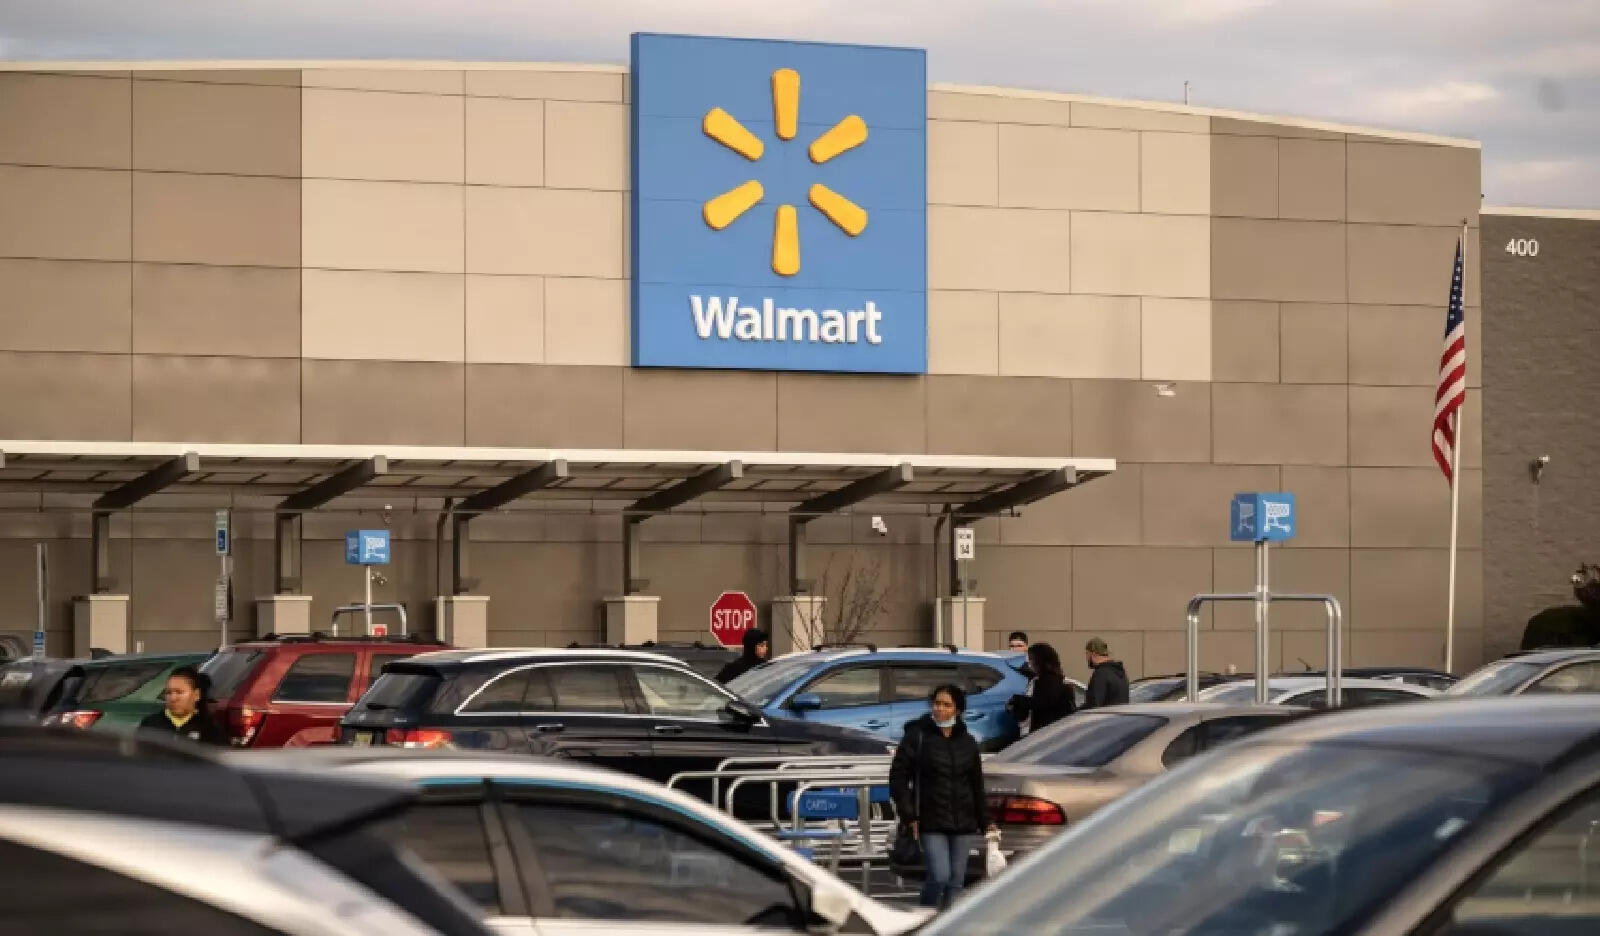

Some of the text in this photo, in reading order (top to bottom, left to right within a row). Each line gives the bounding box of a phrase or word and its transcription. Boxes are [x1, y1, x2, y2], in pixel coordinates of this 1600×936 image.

[1505, 238, 1539, 257] 400
[690, 295, 882, 344] Walmart
[713, 608, 752, 630] STOP
